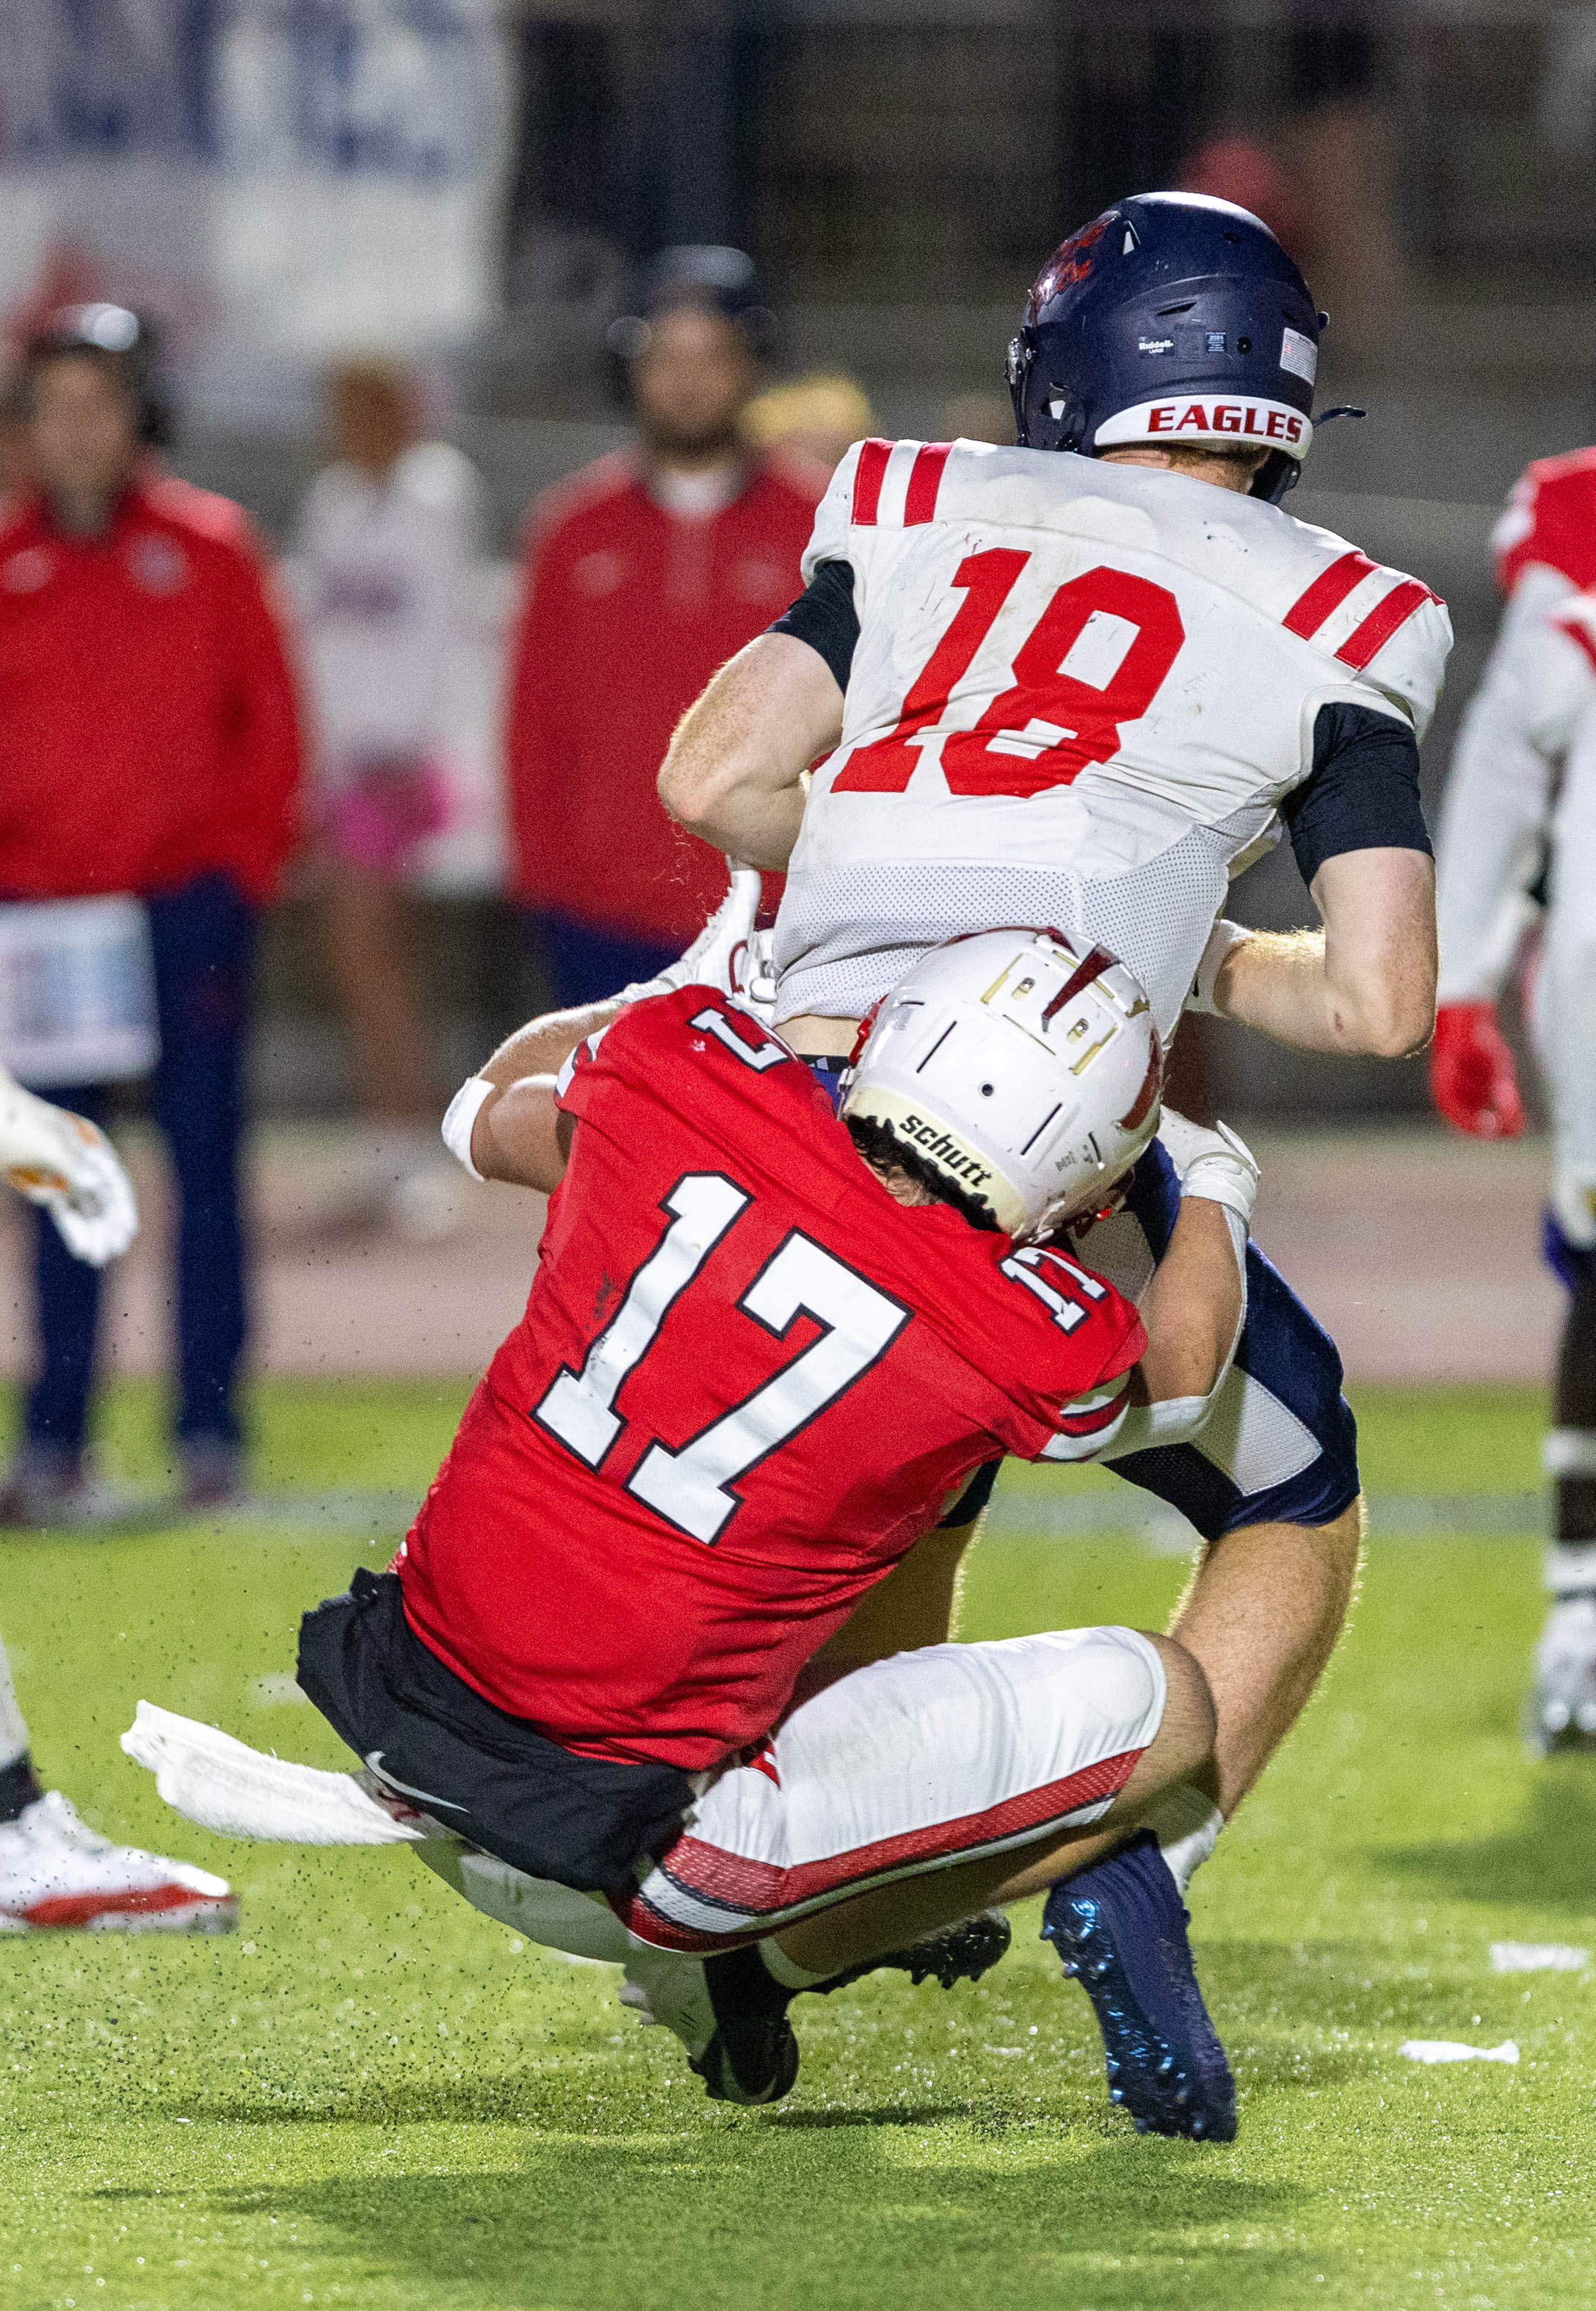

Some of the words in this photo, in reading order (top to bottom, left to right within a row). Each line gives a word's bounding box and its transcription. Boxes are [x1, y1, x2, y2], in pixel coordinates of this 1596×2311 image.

[1139, 340, 1173, 350] Riddell
[1147, 404, 1303, 444] EAGLES
[830, 547, 1186, 799] 18
[899, 1114, 992, 1188] schutt
[997, 1247, 1110, 1338] 17
[529, 1170, 915, 1547] 17
